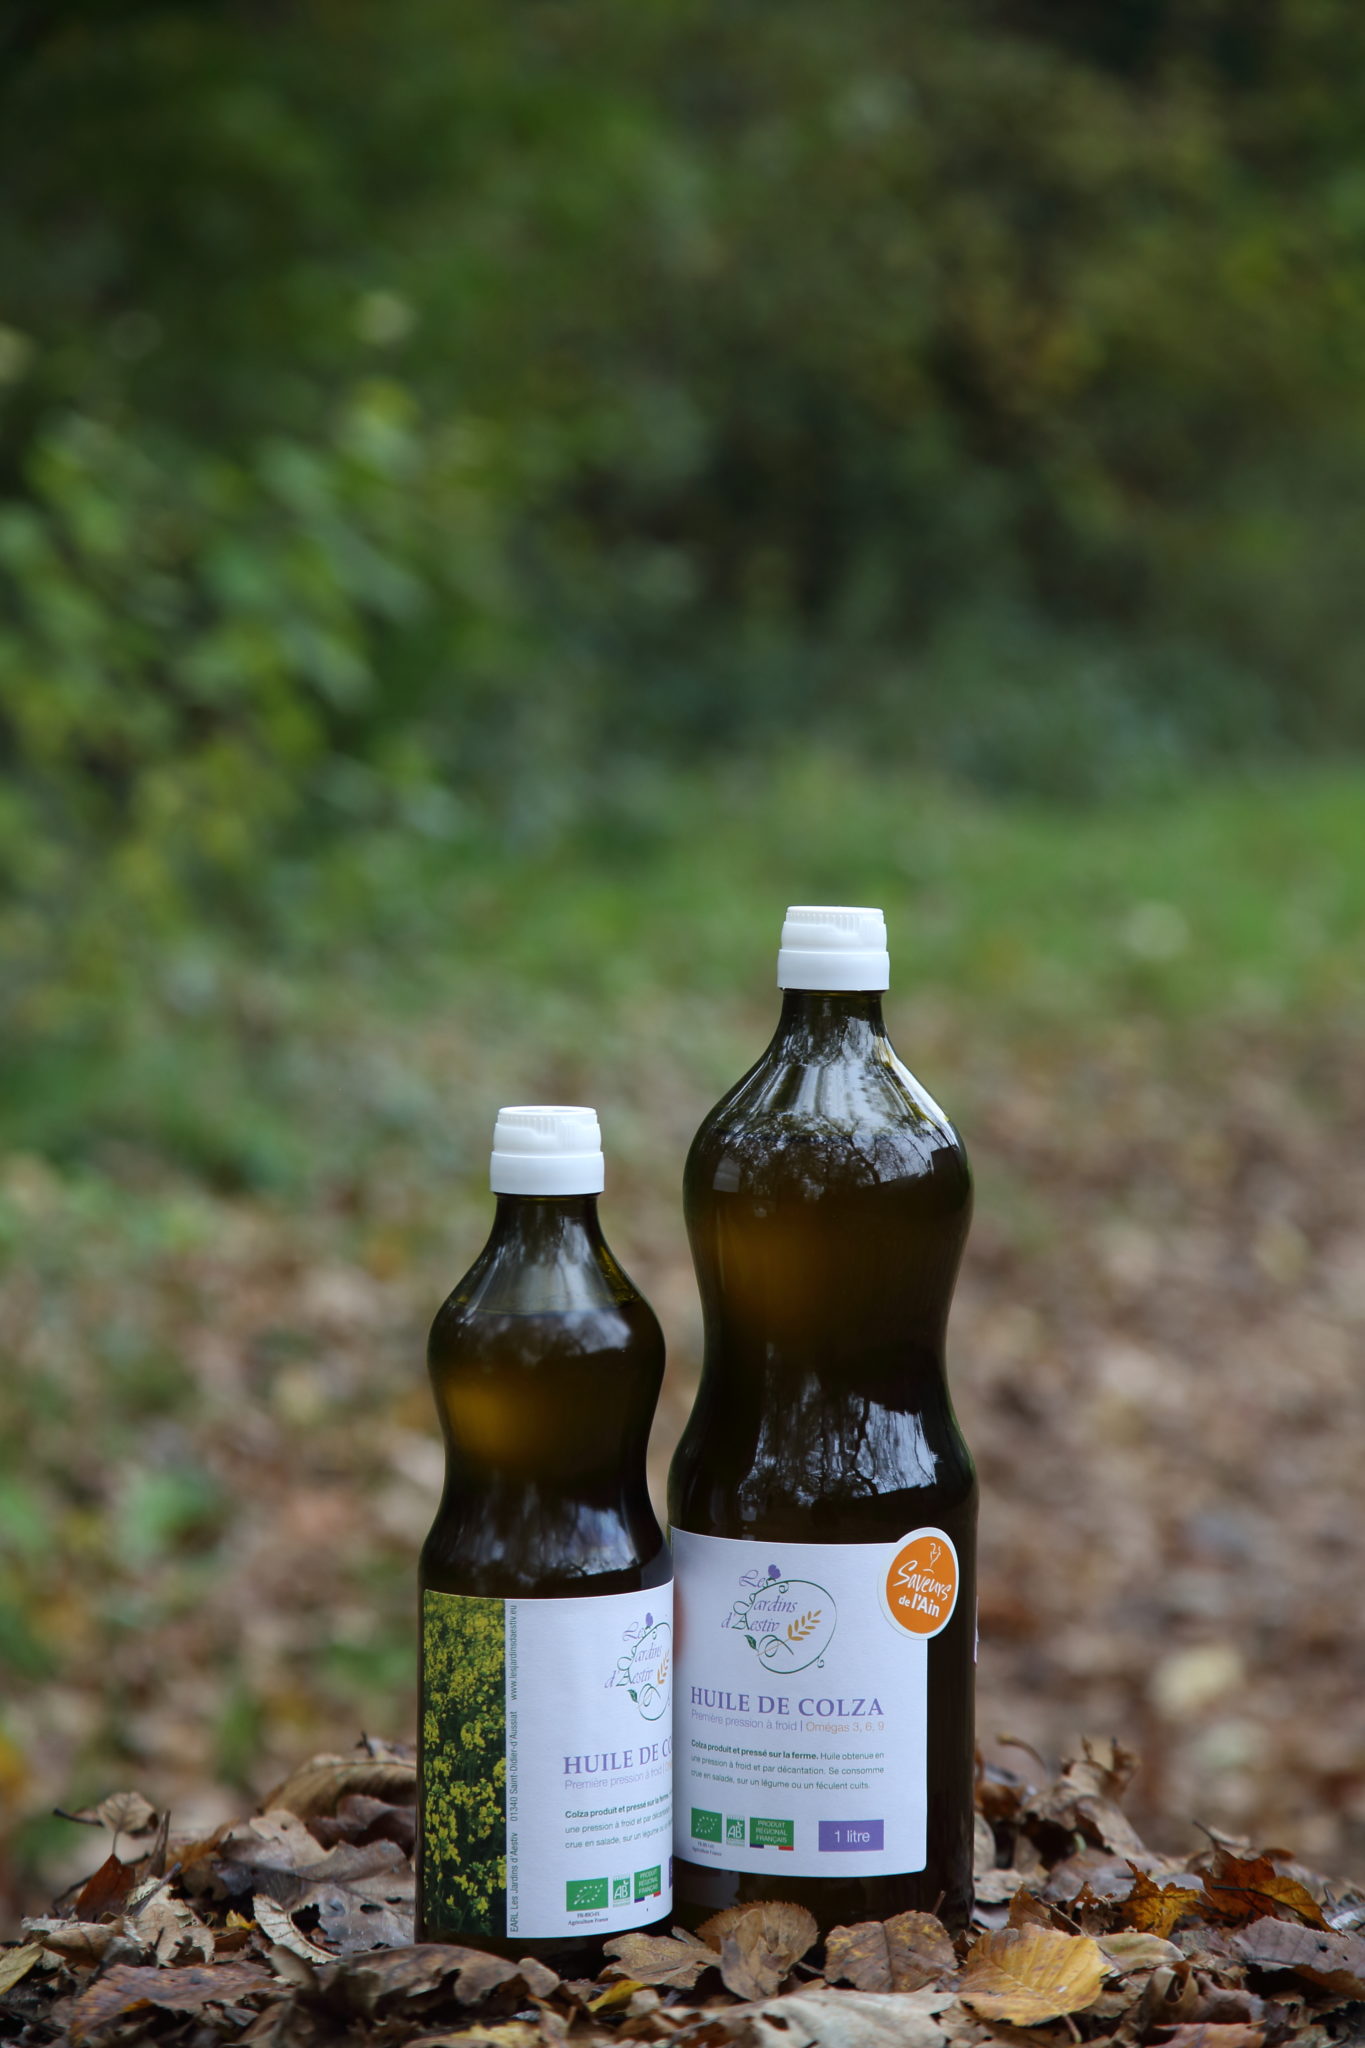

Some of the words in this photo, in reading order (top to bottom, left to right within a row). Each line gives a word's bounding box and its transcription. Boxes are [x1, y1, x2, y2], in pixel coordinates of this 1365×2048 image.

[893, 1560, 952, 1601] Saveurs
[733, 1593, 798, 1615] Jardins
[898, 1595, 910, 1607] de
[911, 1593, 940, 1618] l'Ain
[690, 1686, 750, 1712] HUILE
[758, 1695, 790, 1715] DE
[798, 1698, 884, 1717] COLZA
[725, 1717, 764, 1729] pression
[775, 1720, 798, 1731] froid
[563, 1750, 634, 1775] HUILE
[639, 1743, 659, 1766] DE
[691, 1739, 707, 1750] Colza
[707, 1742, 732, 1753] produit
[732, 1747, 740, 1755] et
[741, 1747, 767, 1758] pressé
[768, 1751, 782, 1759] sur
[783, 1751, 791, 1760] la
[820, 1751, 840, 1761] Huile
[842, 1752, 874, 1761] obtenue
[875, 1752, 885, 1760] en
[735, 1760, 752, 1771] froid
[753, 1763, 761, 1771] et
[762, 1764, 775, 1773] par
[828, 1766, 839, 1776] Se
[841, 1767, 885, 1776] consomme
[736, 1777, 748, 1785] sur
[750, 1777, 760, 1786] un
[791, 1782, 802, 1790] ou
[803, 1781, 814, 1790] un
[815, 1780, 848, 1790] féculent
[510, 1797, 519, 1822] 01340
[565, 1809, 589, 1819] Colza
[590, 1806, 617, 1818] produit
[618, 1804, 626, 1813] et
[565, 1825, 580, 1834] une
[582, 1822, 614, 1834] pression
[727, 1824, 743, 1839] AB
[833, 1829, 841, 1843] 1
[847, 1829, 871, 1844] litre
[510, 1832, 519, 1864] d'Aestiv
[565, 1840, 583, 1849] crue
[584, 1839, 595, 1848] en
[510, 1864, 519, 1894] Jardins
[614, 1885, 628, 1899] AB
[510, 1895, 519, 1910] Les
[510, 1912, 519, 1932] EARL
